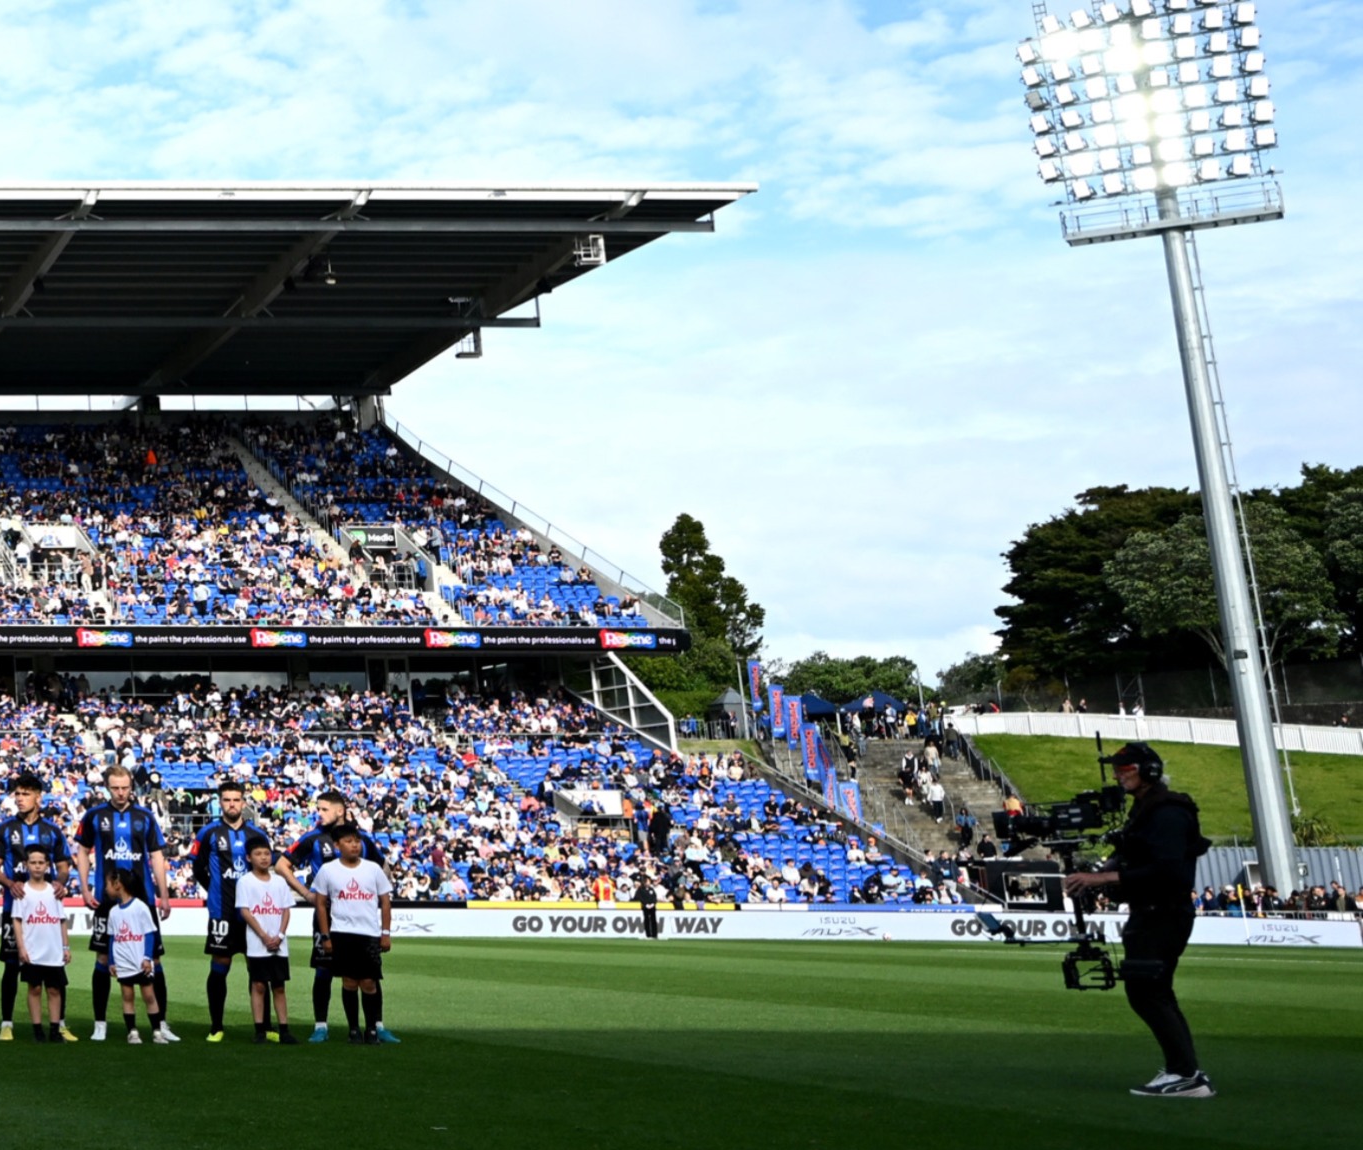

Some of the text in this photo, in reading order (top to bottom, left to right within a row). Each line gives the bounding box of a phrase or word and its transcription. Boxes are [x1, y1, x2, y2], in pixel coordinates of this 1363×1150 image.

[10, 636, 57, 646] professionals
[58, 637, 72, 645] use
[79, 632, 127, 645] Resene
[253, 633, 420, 646] Resene the paint the professionals use
[427, 634, 595, 647] Resene the paint the professionals use
[603, 634, 651, 647] Resene
[105, 849, 142, 861] Anchor
[338, 890, 374, 901] Anchor
[512, 915, 543, 932] GO
[548, 916, 607, 933] YOUR
[675, 917, 723, 933] WAY
[819, 916, 856, 925] ISUZU
[211, 919, 229, 936] 10
[951, 919, 982, 936] GO
[1261, 923, 1299, 932] ISUZU
